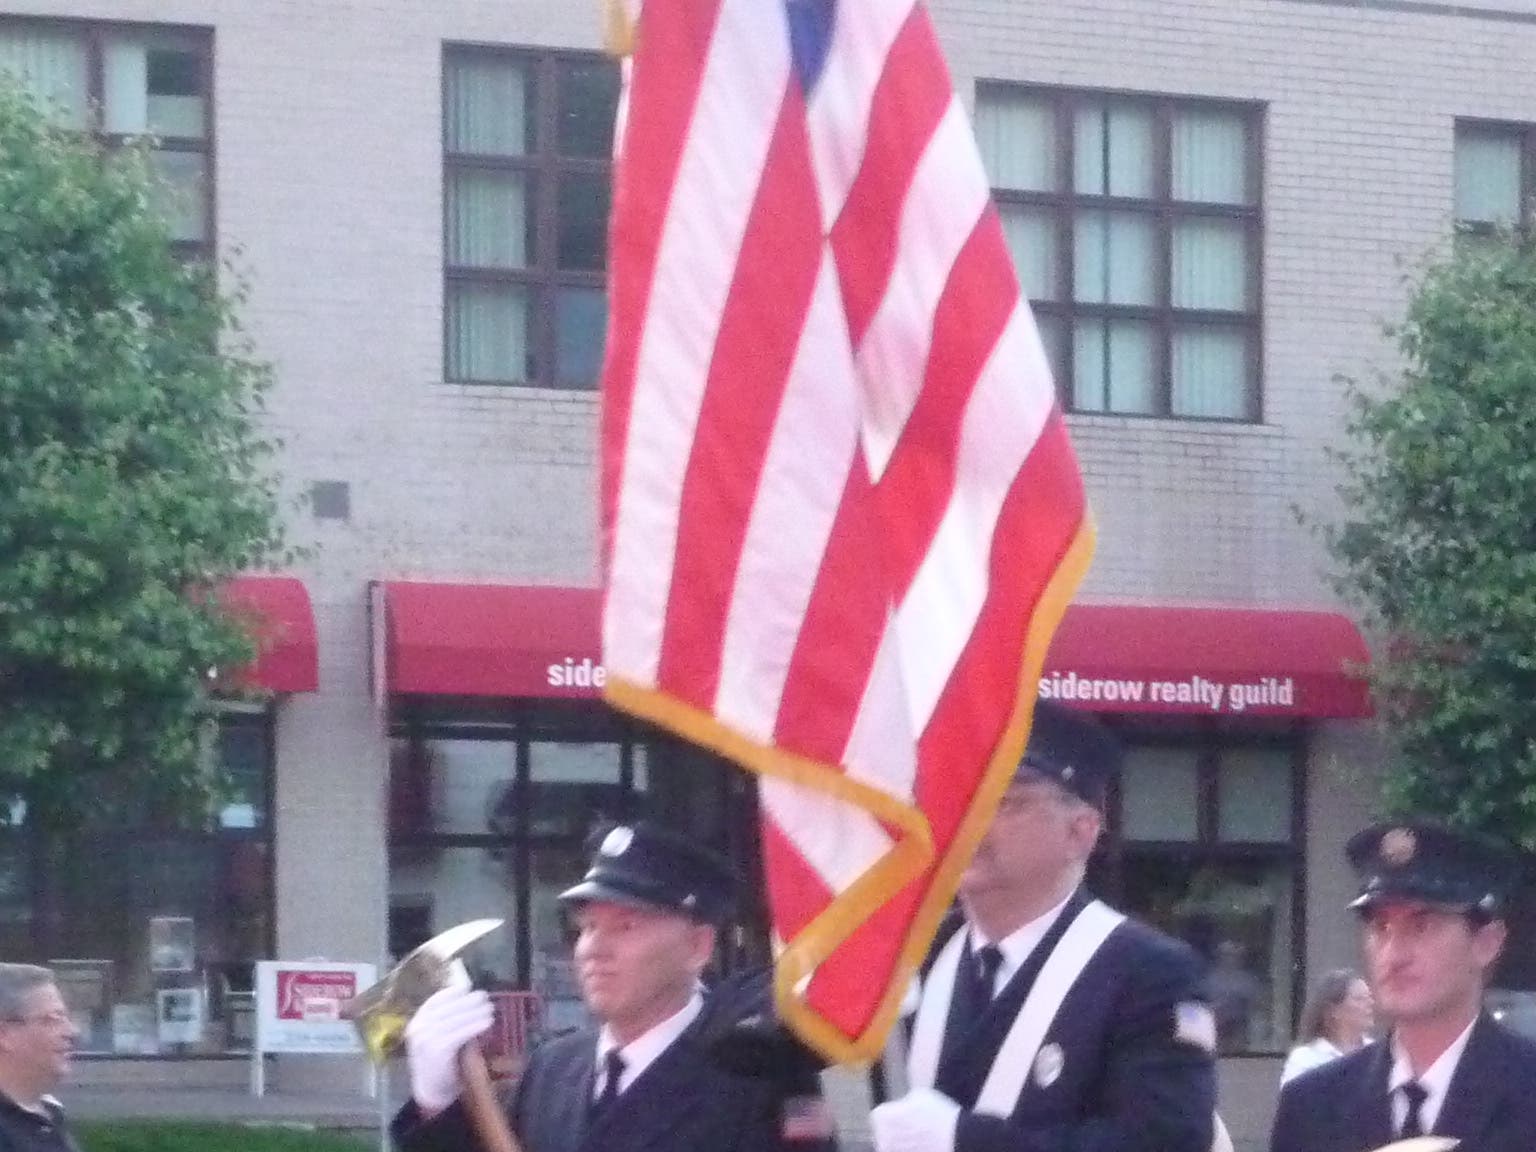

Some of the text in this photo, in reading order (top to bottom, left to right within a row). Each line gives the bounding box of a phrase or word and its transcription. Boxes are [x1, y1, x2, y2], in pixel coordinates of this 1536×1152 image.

[547, 657, 606, 687] side
[1038, 671, 1294, 711] siderow realty guild
